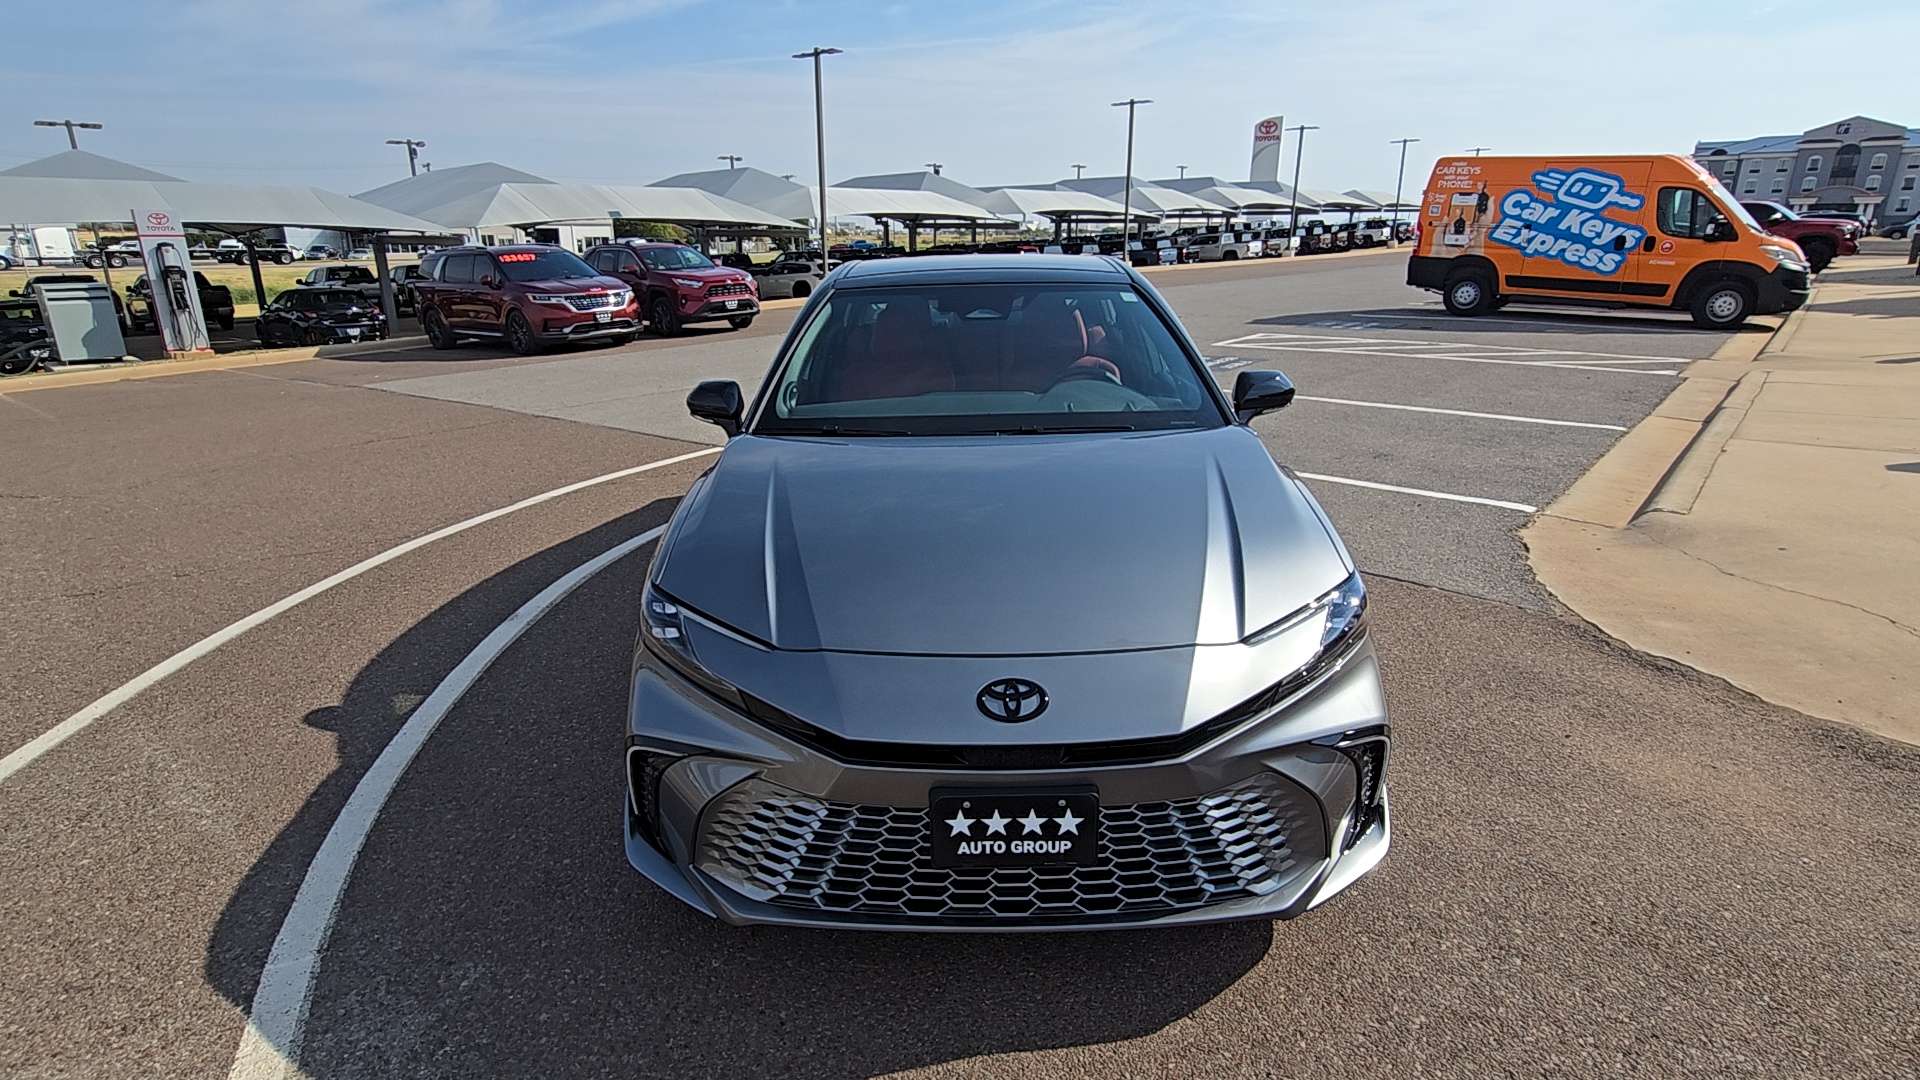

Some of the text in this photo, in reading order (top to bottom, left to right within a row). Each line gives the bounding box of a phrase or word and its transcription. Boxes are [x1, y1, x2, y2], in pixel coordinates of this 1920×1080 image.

[1437, 180, 1473, 188] PHONE!
[1503, 193, 1642, 249] Car Keys
[1492, 218, 1622, 272] Express
[957, 840, 1072, 855] AUTO GROUP
